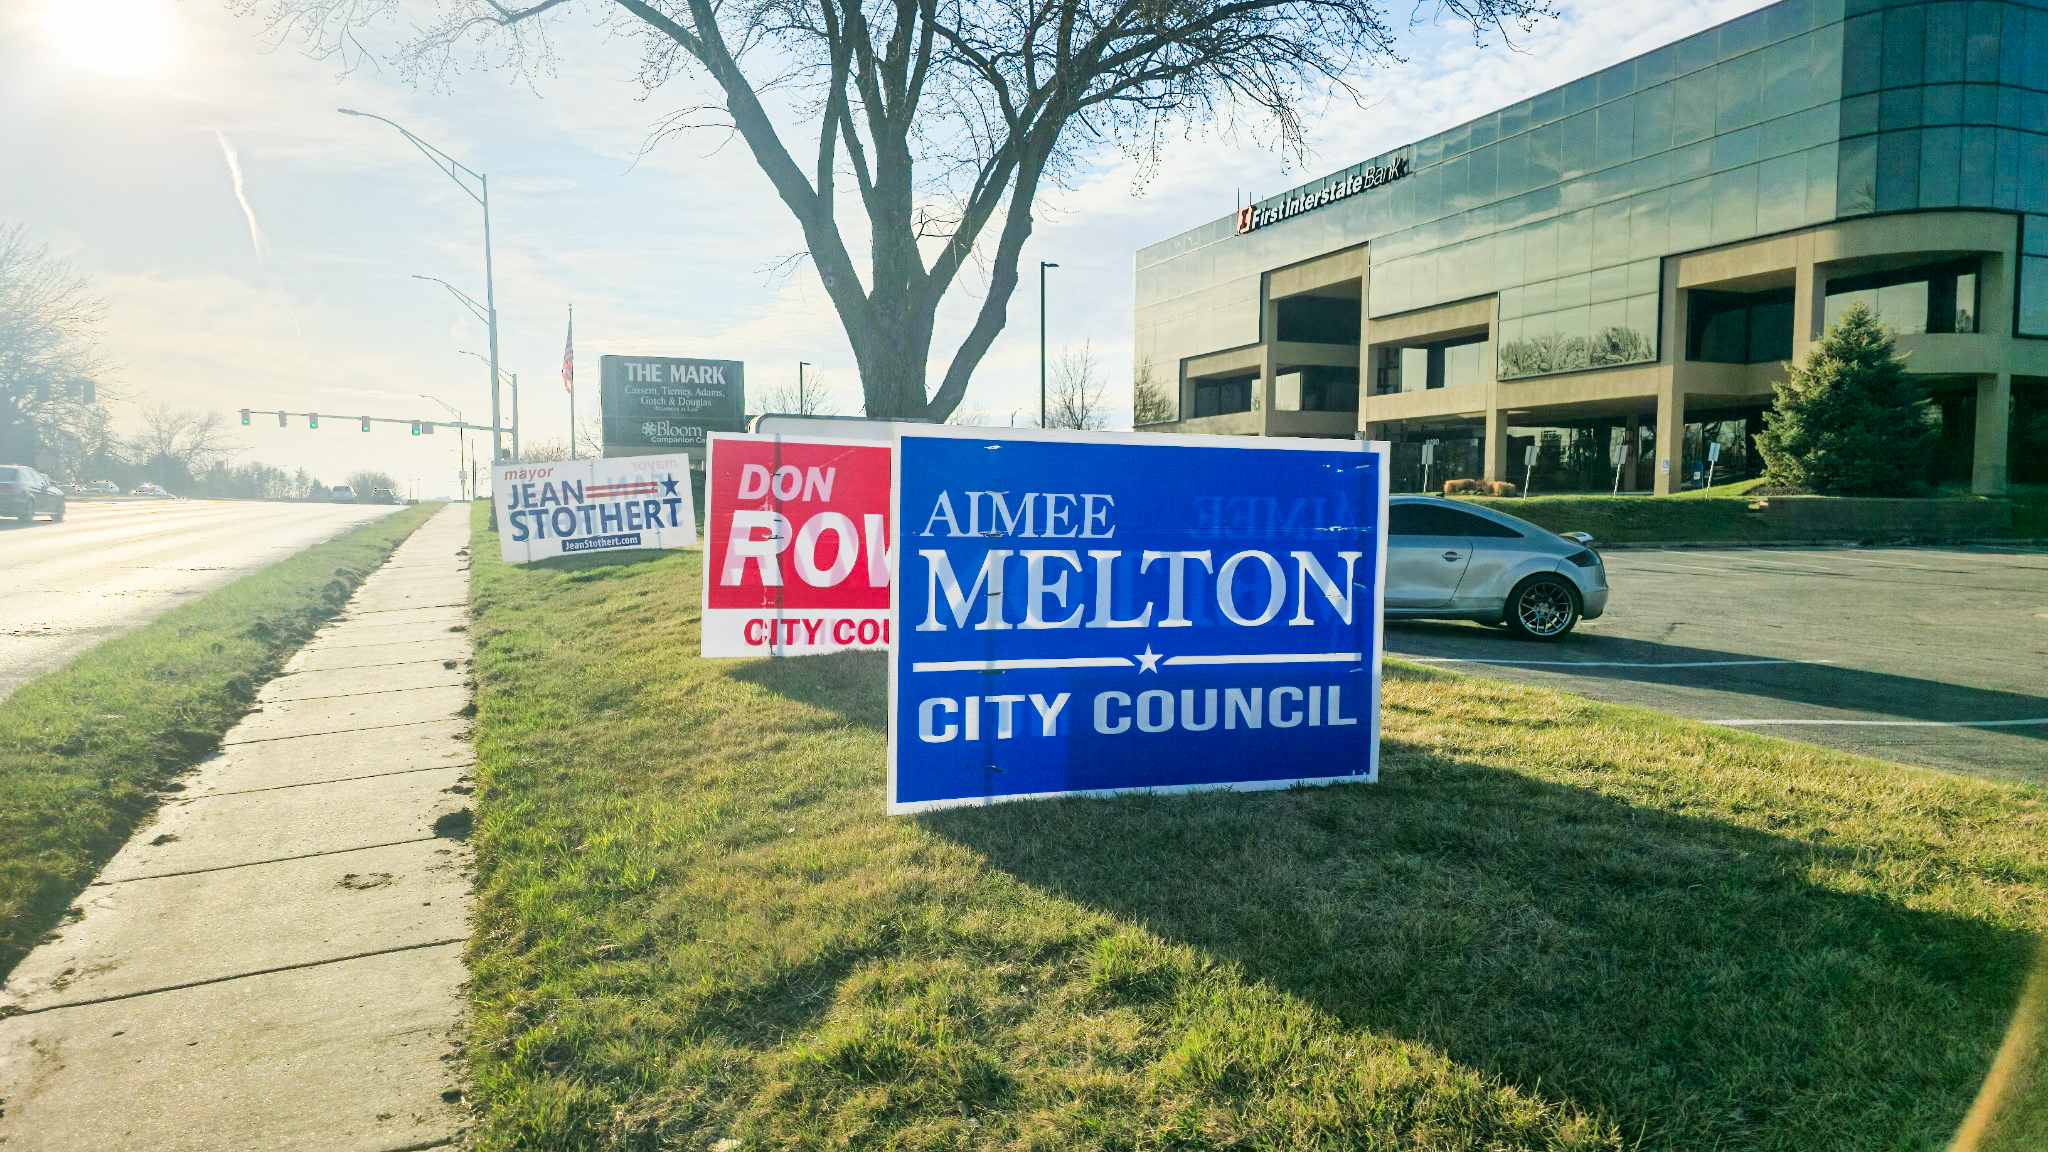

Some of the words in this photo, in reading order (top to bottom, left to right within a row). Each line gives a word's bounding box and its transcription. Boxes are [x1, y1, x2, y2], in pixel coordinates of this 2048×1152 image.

[1363, 157, 1401, 189] Bank
[624, 362, 662, 383] THE
[670, 364, 726, 385] MARK
[640, 395, 666, 406] Gotch
[668, 396, 676, 406] &
[678, 397, 712, 409] Douglas
[651, 436, 695, 445] Companion
[656, 419, 704, 437] Bloom
[504, 467, 554, 482] mayor
[737, 463, 836, 503] DON
[507, 479, 585, 511] JEAN
[509, 497, 682, 542] STOTHERT
[919, 489, 1117, 539] AIMEE
[565, 536, 639, 551] JeanStothert.com
[915, 549, 1363, 632] MELTON
[743, 618, 824, 646] CITY
[832, 618, 890, 646] CO
[918, 692, 1072, 744] CITY
[1093, 686, 1358, 735] COUNCIL
